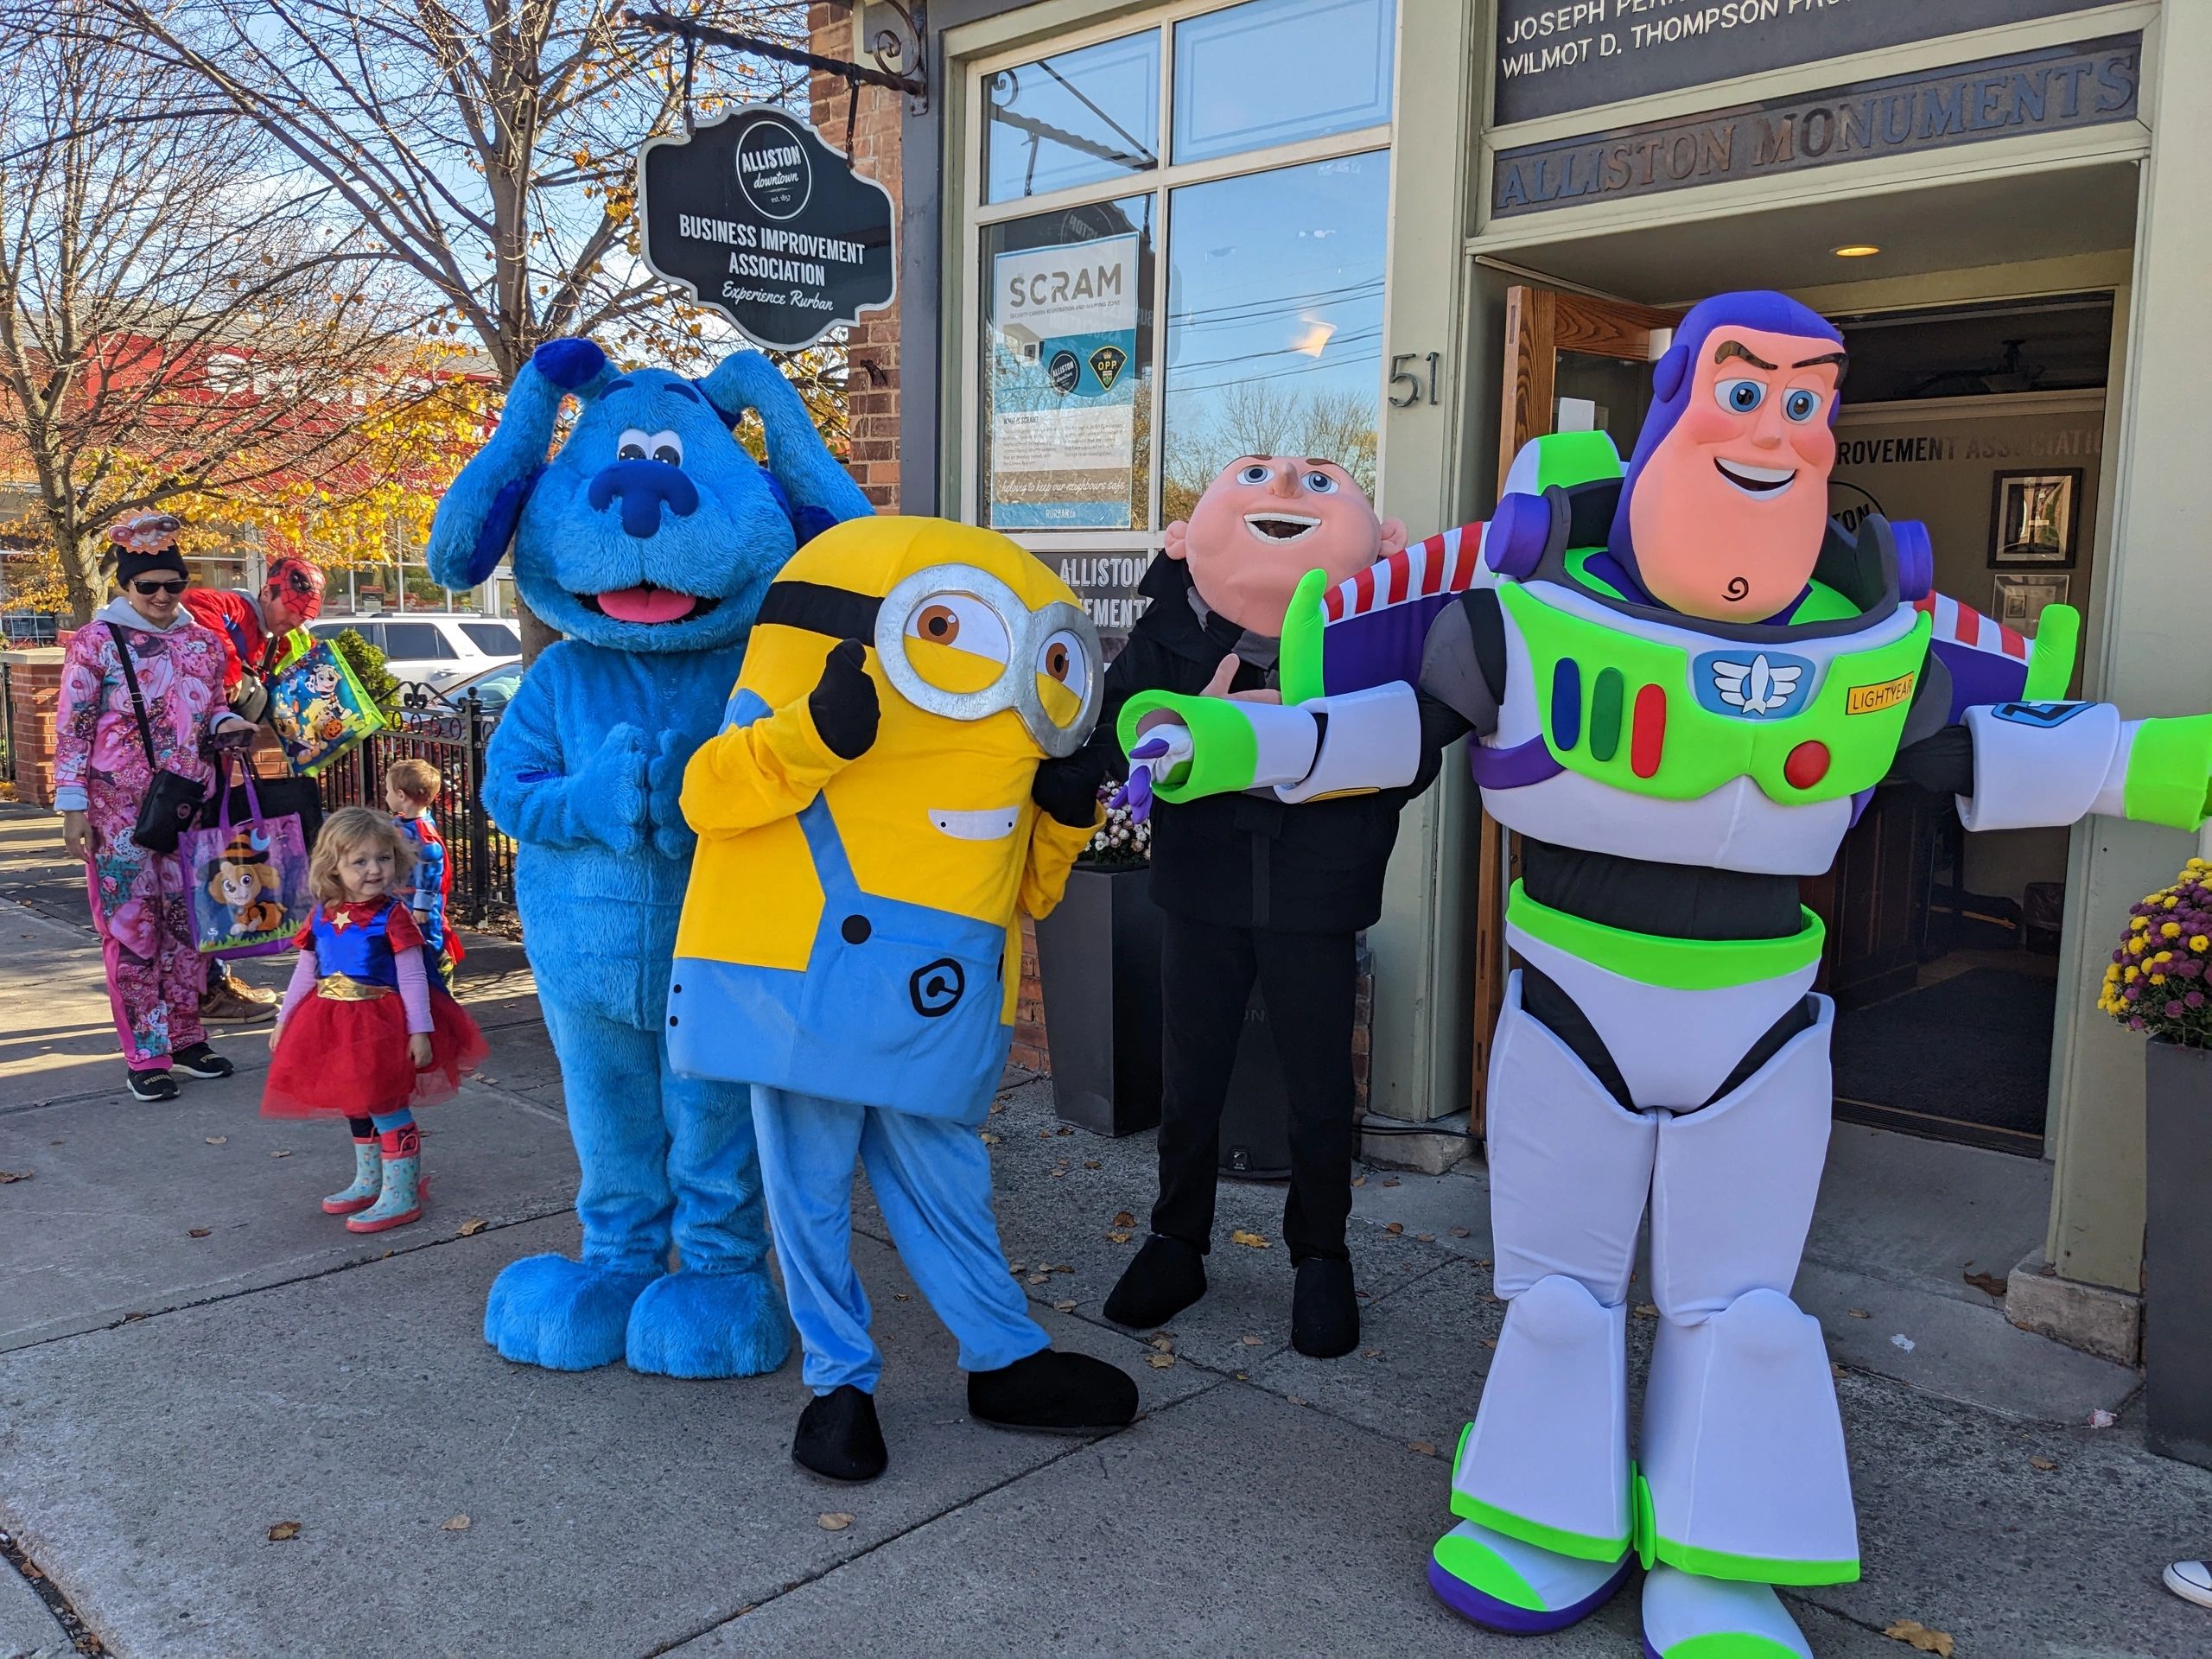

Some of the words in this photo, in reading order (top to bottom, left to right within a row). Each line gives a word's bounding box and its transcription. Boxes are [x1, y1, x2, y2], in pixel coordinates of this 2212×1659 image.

[1506, 0, 1605, 44] JOSEPH
[1503, 38, 1593, 79] WILMOT
[1600, 33, 1622, 56] D.
[1630, 0, 1779, 49] THOMPSON
[1497, 124, 1734, 207] ALLISTON
[1753, 54, 2133, 167] MONUMENTS
[741, 144, 801, 174] ALLISTON
[753, 172, 799, 189] downtown
[679, 214, 757, 249] BUSINESS
[760, 227, 866, 264] IMPROVEMENT
[728, 252, 826, 287] ASSOCIATION
[1009, 263, 1122, 308] SCRAM
[721, 281, 786, 305] Experience
[790, 289, 834, 311] Rurban
[1052, 359, 1074, 378] ALLISTON
[1389, 352, 1440, 407] 51
[1837, 436, 1955, 465] ROVEMENT
[1001, 480, 1027, 496] helping
[1036, 480, 1052, 495] keep
[1066, 477, 1105, 496] neighbours
[1060, 557, 1147, 587] ALLISTON
[1853, 678, 1913, 710] LIGHTYEAR
